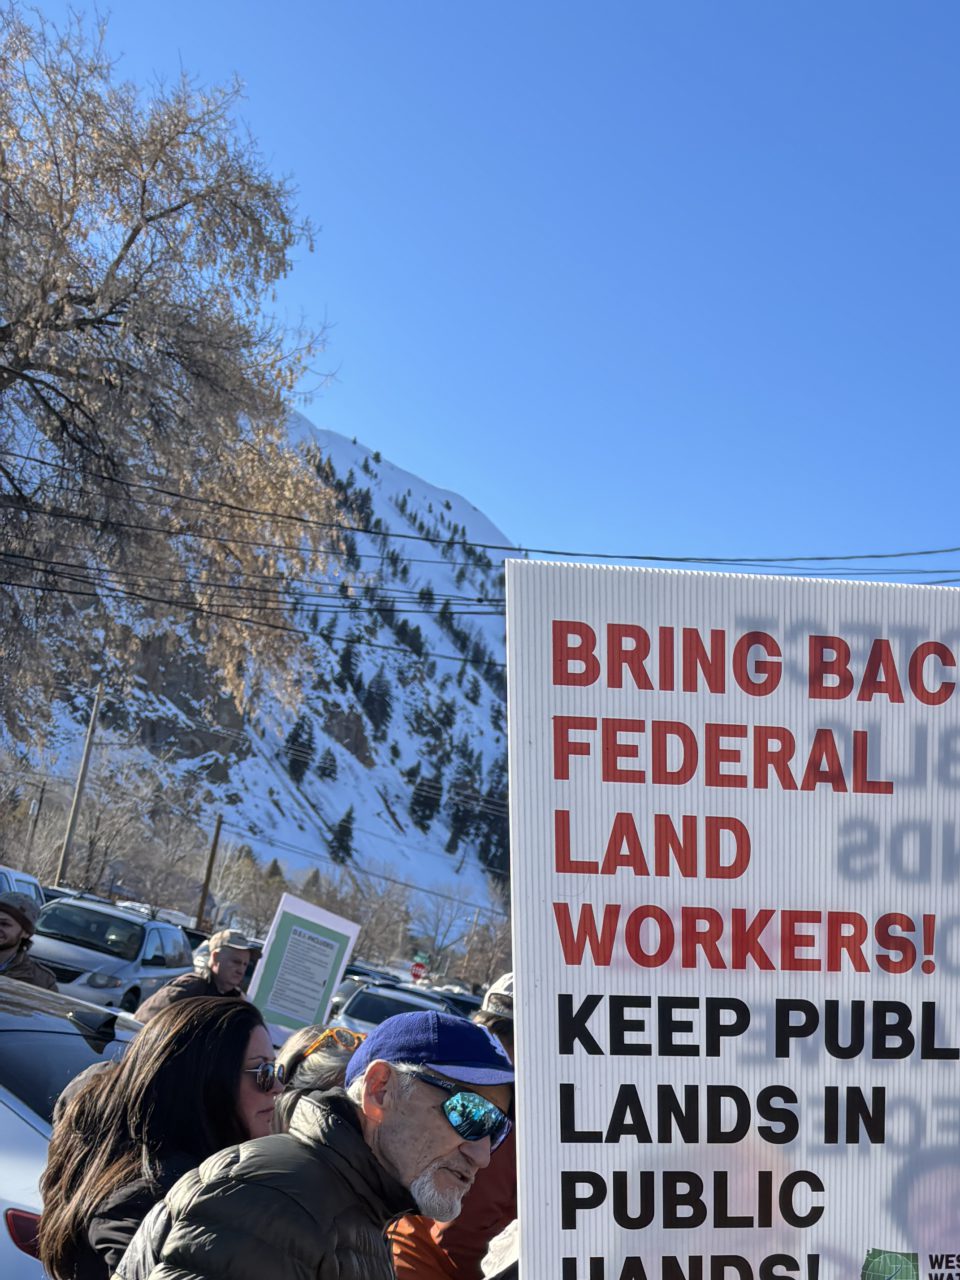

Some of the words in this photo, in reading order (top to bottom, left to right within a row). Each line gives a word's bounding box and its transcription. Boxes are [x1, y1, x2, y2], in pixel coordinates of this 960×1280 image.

[552, 621, 782, 696] BRING
[552, 716, 894, 795] FEDERAL
[554, 810, 752, 880] LAND
[552, 903, 937, 976] WORKERS!
[557, 993, 752, 1057] KEEP
[559, 1083, 800, 1145] LANDS
[823, 1086, 886, 1145] IN
[561, 1170, 825, 1231] PUBLIC
